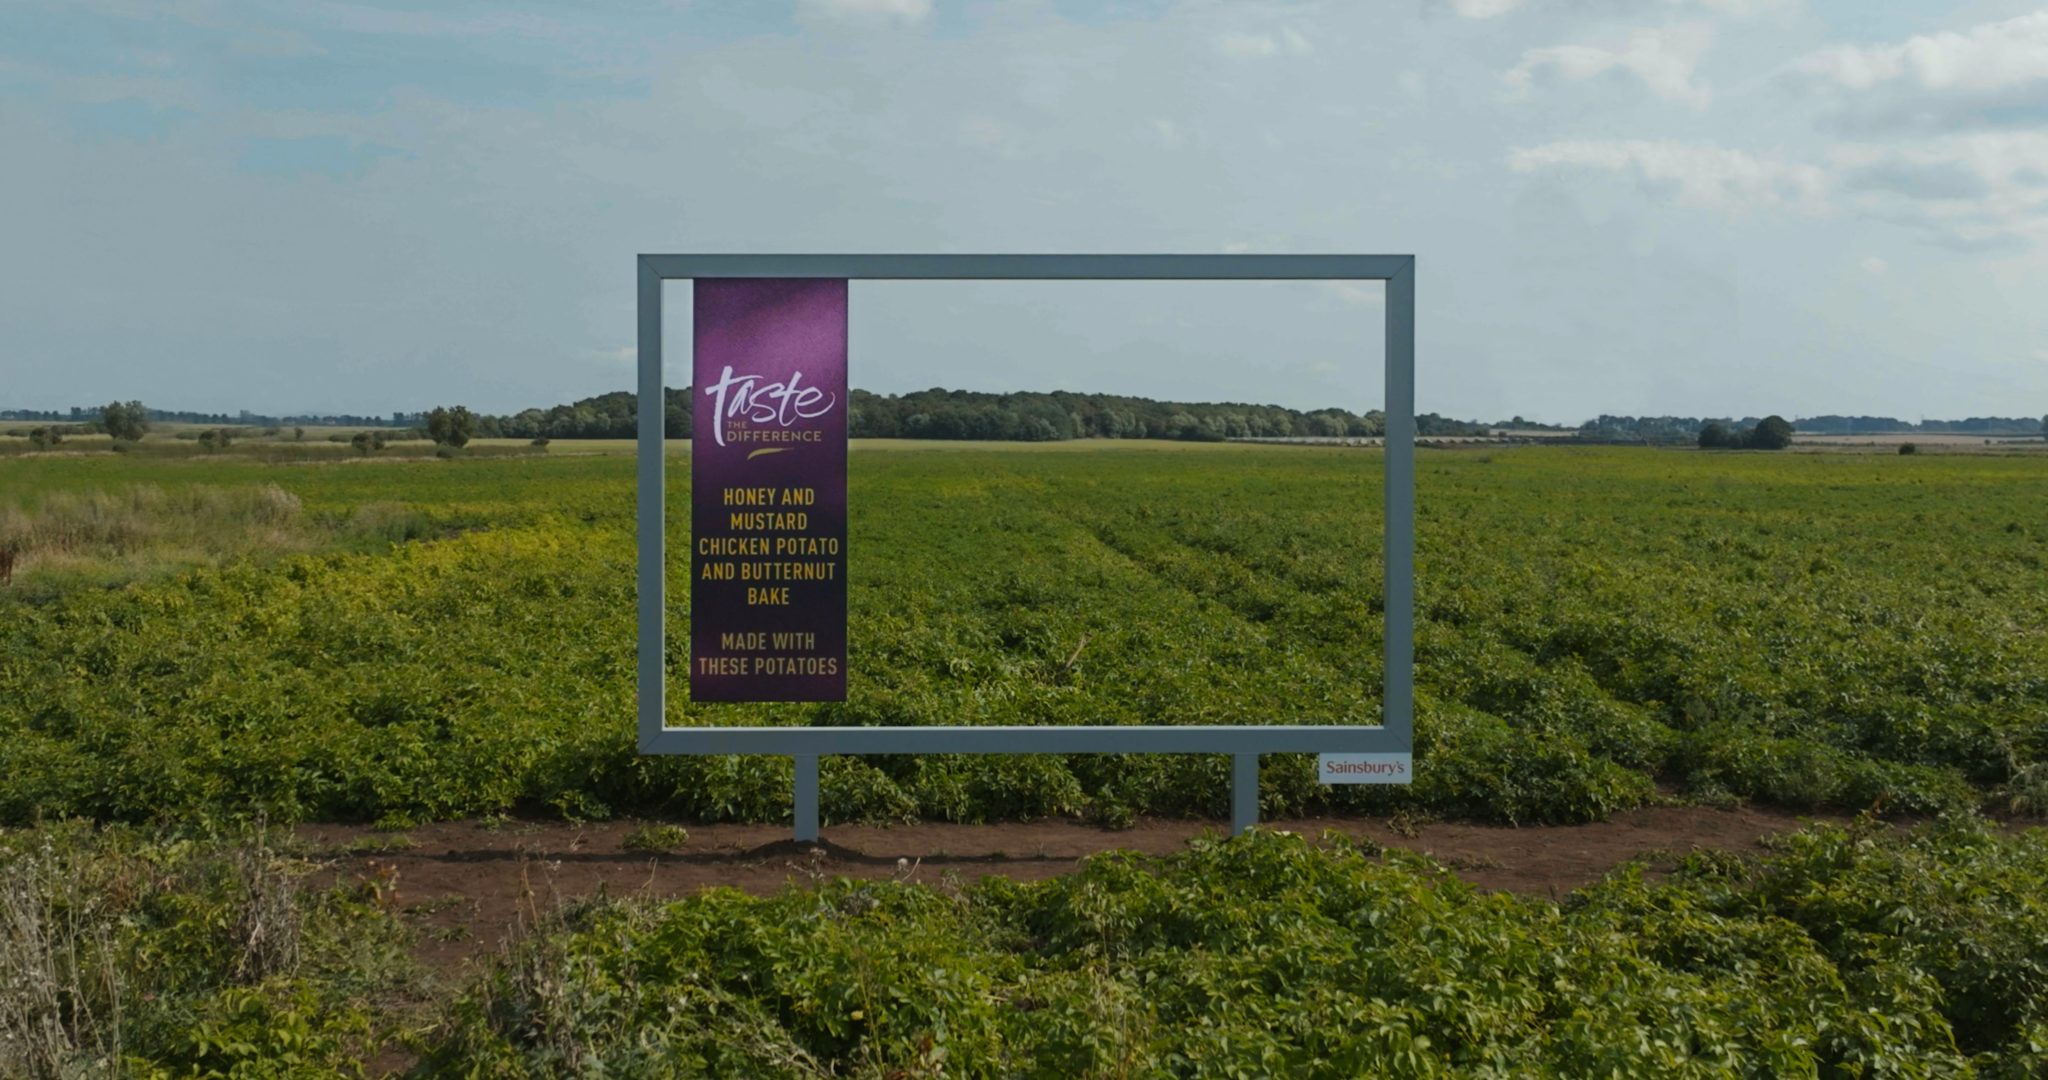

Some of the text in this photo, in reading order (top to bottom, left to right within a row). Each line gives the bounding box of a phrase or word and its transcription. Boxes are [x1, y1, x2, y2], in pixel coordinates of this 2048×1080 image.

[705, 365, 836, 447] taste
[727, 421, 747, 429] THE
[726, 431, 822, 442] DIFFERENCE
[723, 488, 815, 505] HONEY AND
[730, 513, 808, 530] MUSTARD
[699, 538, 838, 555] CHICKEN POTATO
[701, 563, 835, 580] AND BUTTERNUT
[748, 588, 790, 605] BAKE
[721, 633, 815, 650] MADE WITH
[699, 657, 838, 675] THESE POTATOES
[1326, 761, 1404, 776] Sainsbury's
